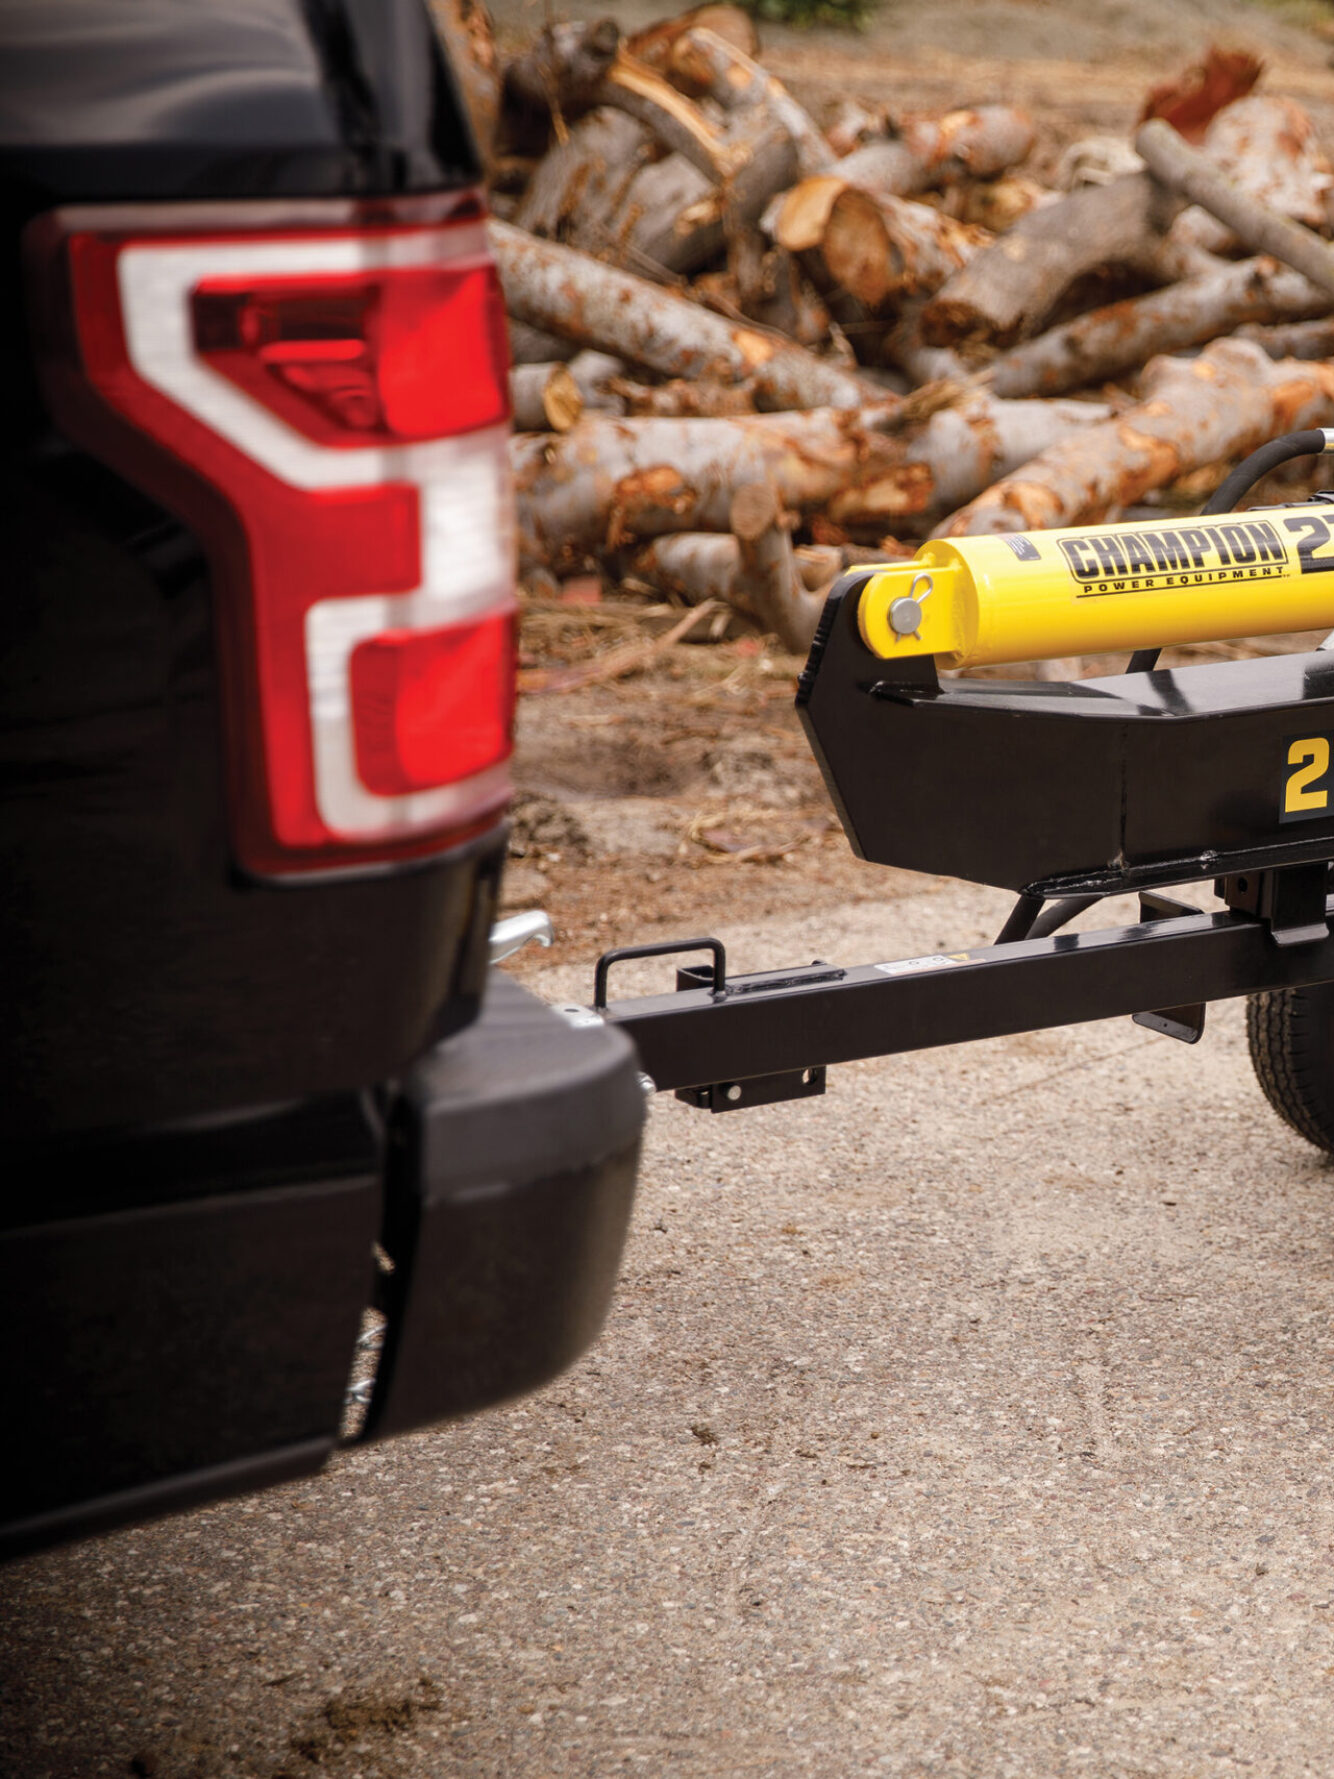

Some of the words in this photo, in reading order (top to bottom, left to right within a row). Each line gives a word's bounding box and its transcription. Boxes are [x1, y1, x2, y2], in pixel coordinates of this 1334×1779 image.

[1060, 522, 1284, 579] CHAMPION
[1083, 579, 1155, 594] POWER
[1166, 566, 1285, 586] EQUIPMENT
